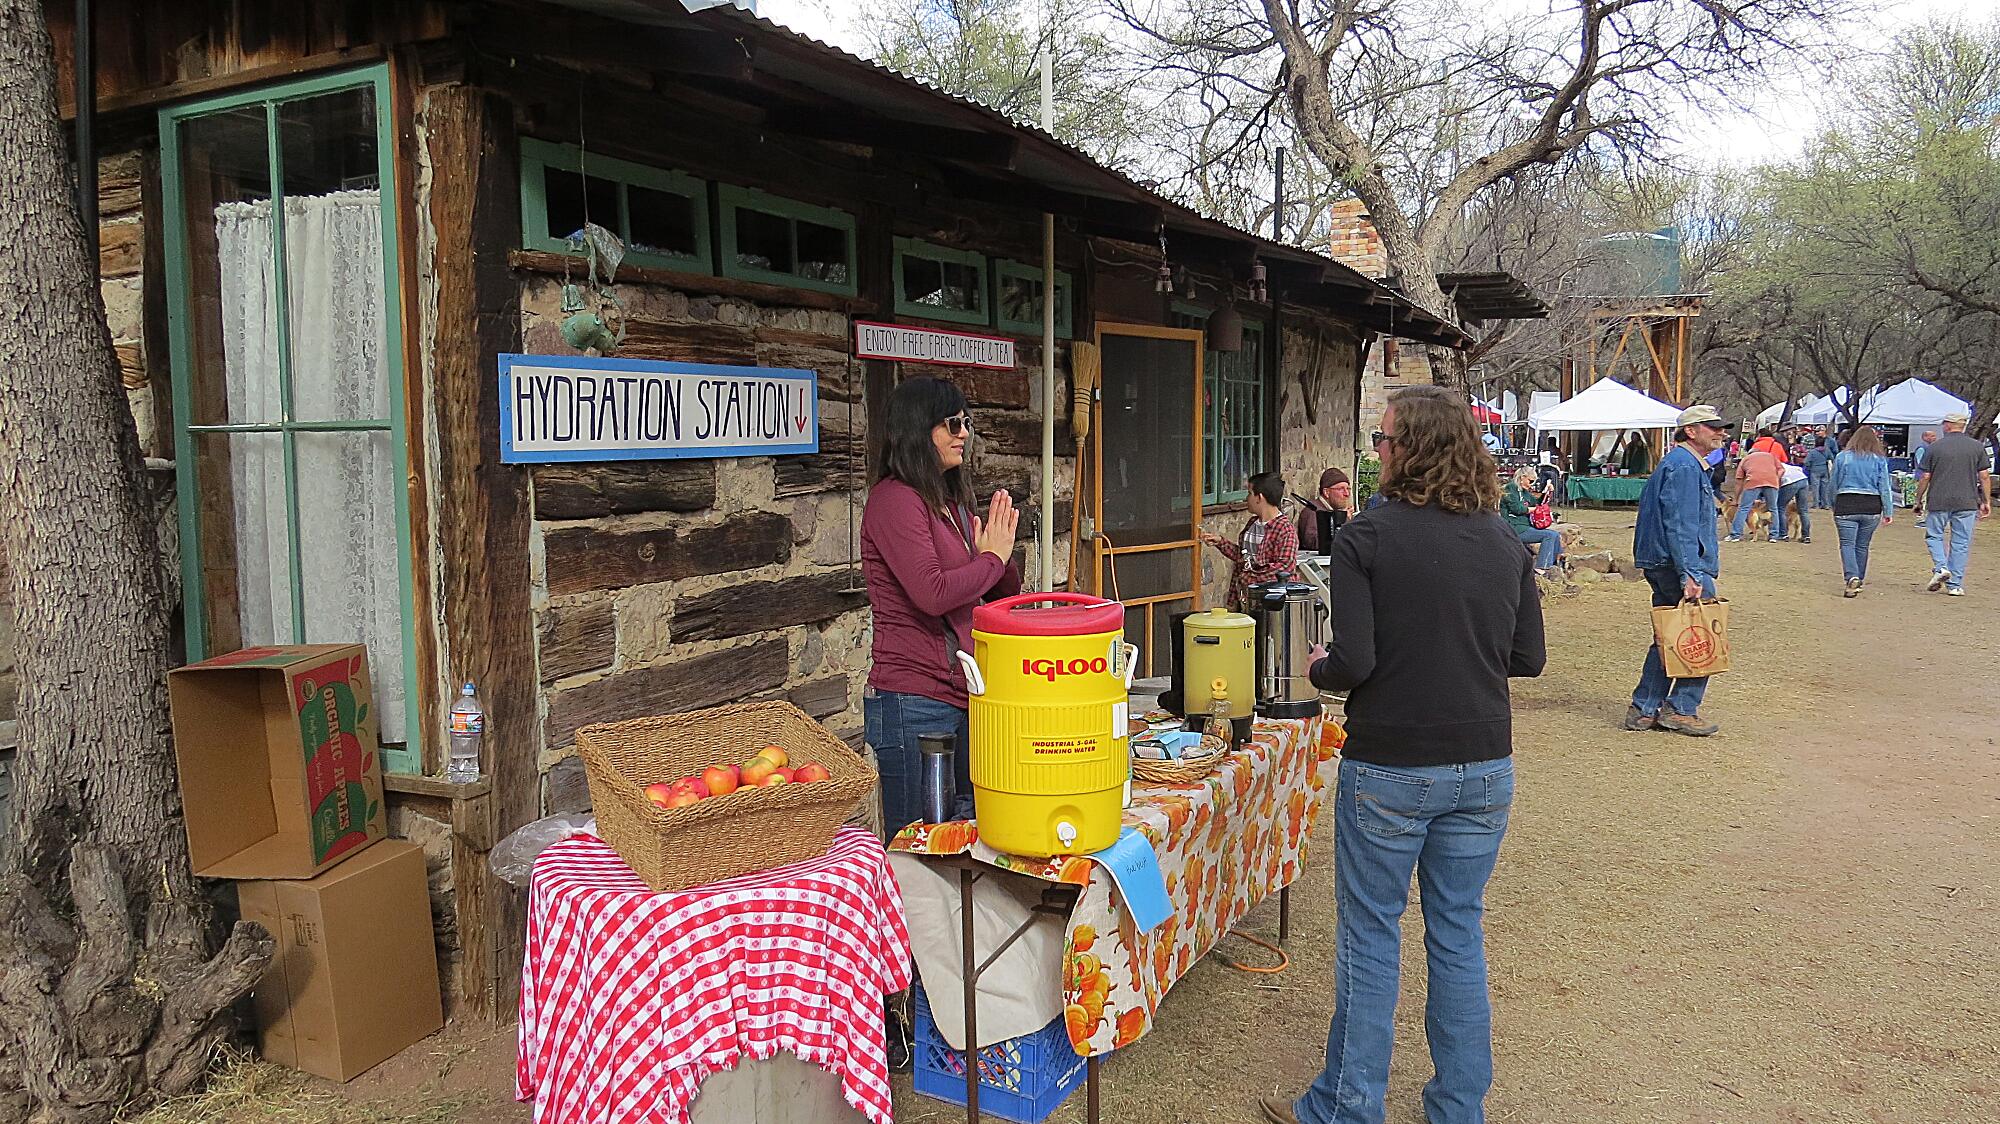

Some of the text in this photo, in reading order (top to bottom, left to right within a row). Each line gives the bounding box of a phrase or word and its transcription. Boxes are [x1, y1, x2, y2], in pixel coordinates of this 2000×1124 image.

[865, 328, 1009, 364] ENJOY FREE FRESH COFFEE & TEA
[515, 374, 790, 442] HYDRATION STATION
[1022, 657, 1108, 682] IGLOO
[323, 687, 351, 831] ORGANIC APPLES
[1074, 746, 1096, 754] WATER
